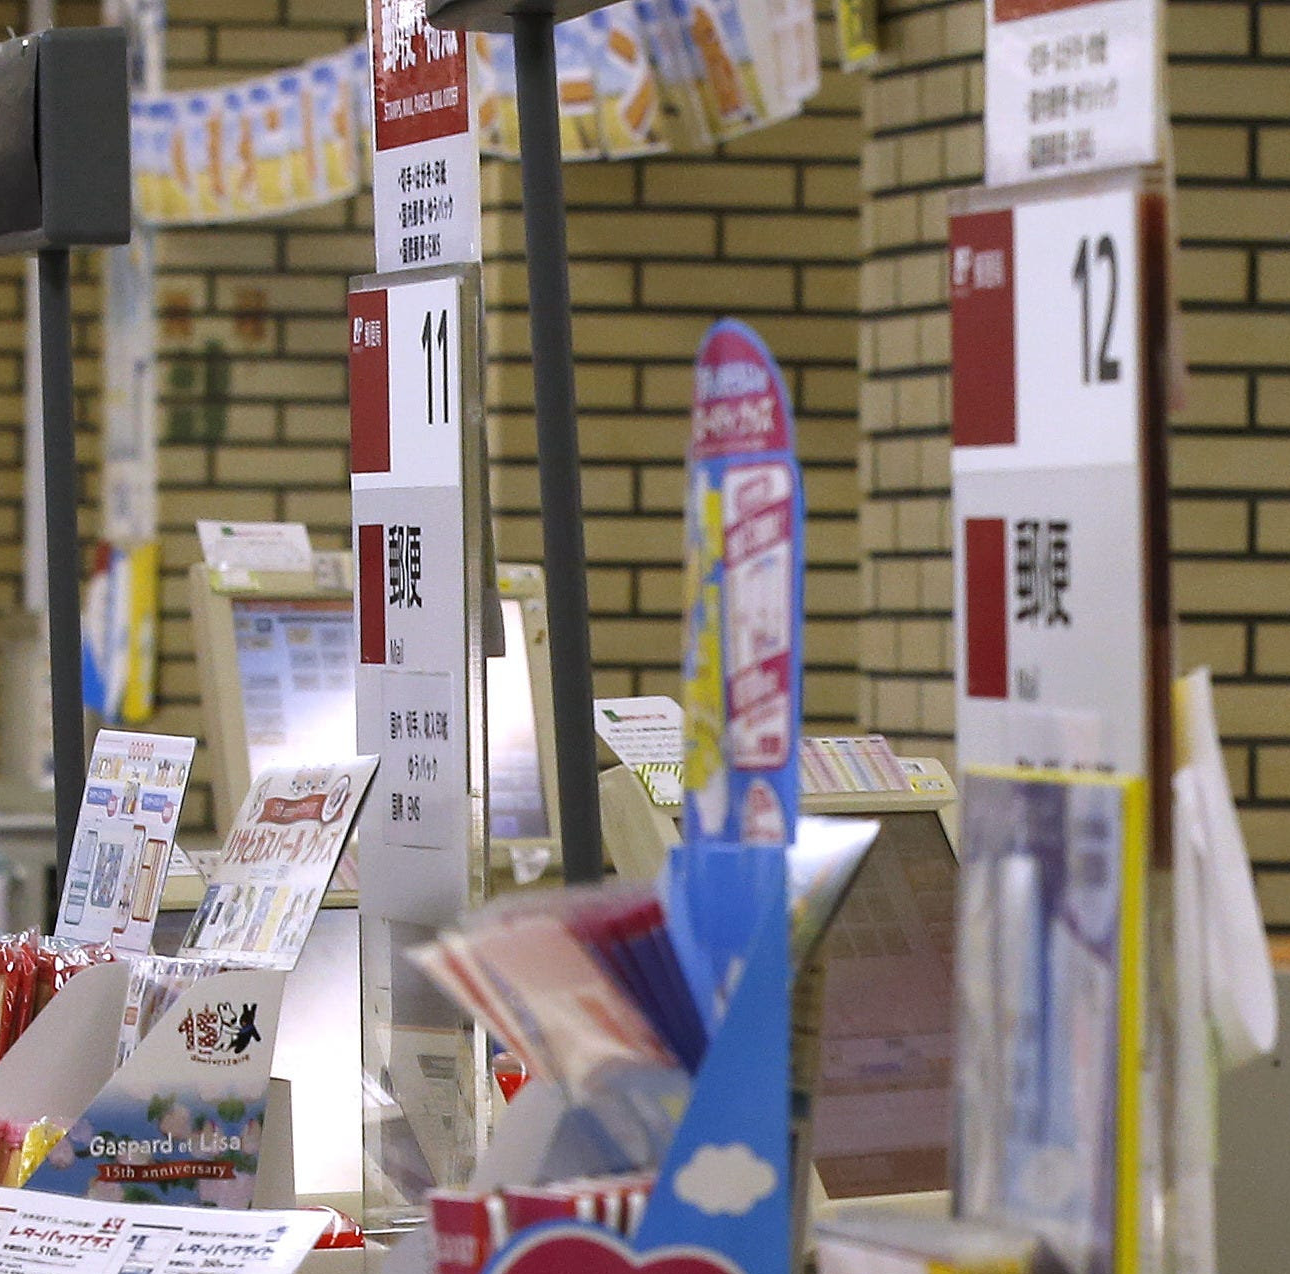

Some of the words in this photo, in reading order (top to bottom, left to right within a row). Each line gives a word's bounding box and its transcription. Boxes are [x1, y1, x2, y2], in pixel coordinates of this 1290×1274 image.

[1071, 233, 1121, 384] 12
[421, 308, 448, 425] 11
[389, 524, 422, 609] 郵便
[1016, 517, 1070, 629] 郵便
[390, 637, 404, 665] Mail
[90, 1132, 173, 1161] Gaspard
[200, 1131, 242, 1151] Lisa
[104, 1166, 136, 1179] 15th
[142, 1163, 227, 1179] anniversary
[9, 1225, 116, 1249] レターパックプラス
